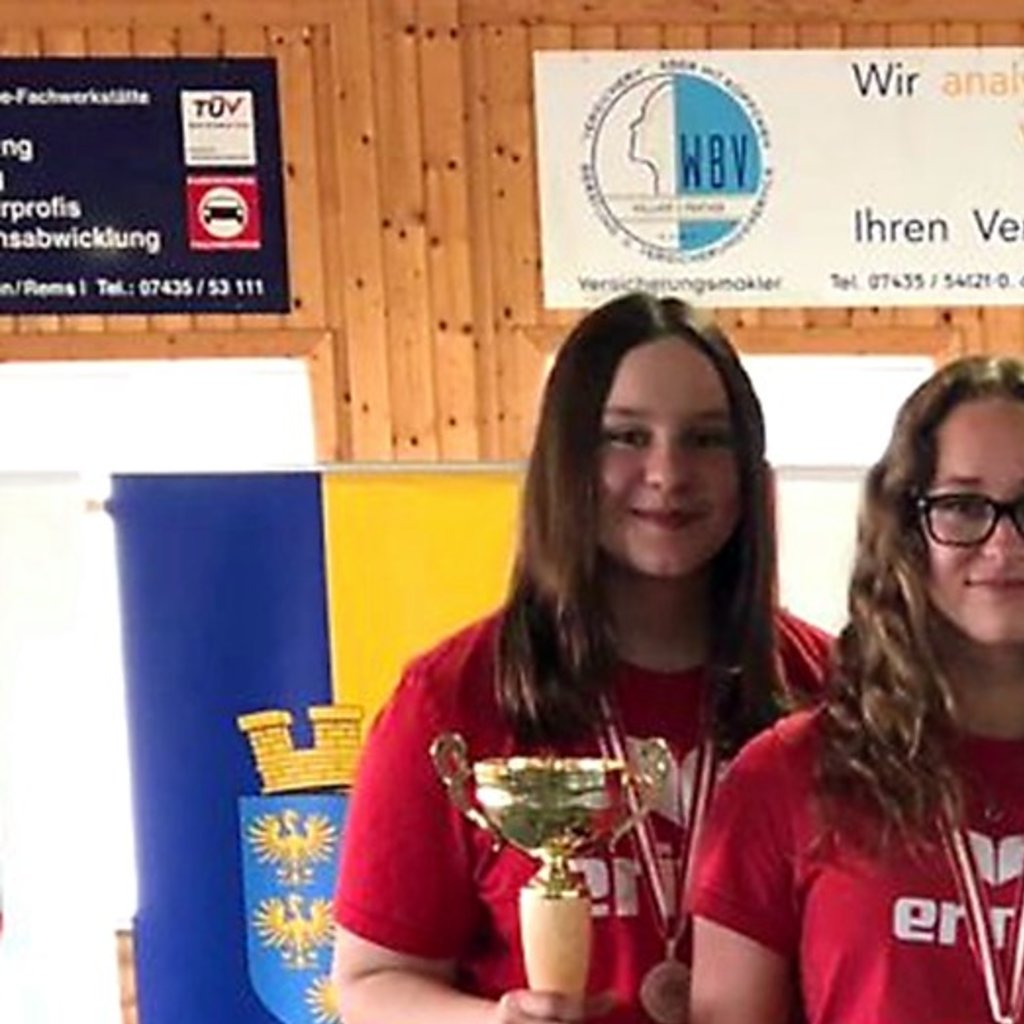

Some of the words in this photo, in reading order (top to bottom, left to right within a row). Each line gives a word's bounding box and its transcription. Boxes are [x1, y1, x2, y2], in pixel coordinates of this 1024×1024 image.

[852, 62, 920, 97] Wir
[193, 96, 246, 118] TÜV
[680, 133, 747, 189] WBV
[853, 207, 948, 243] Ihren
